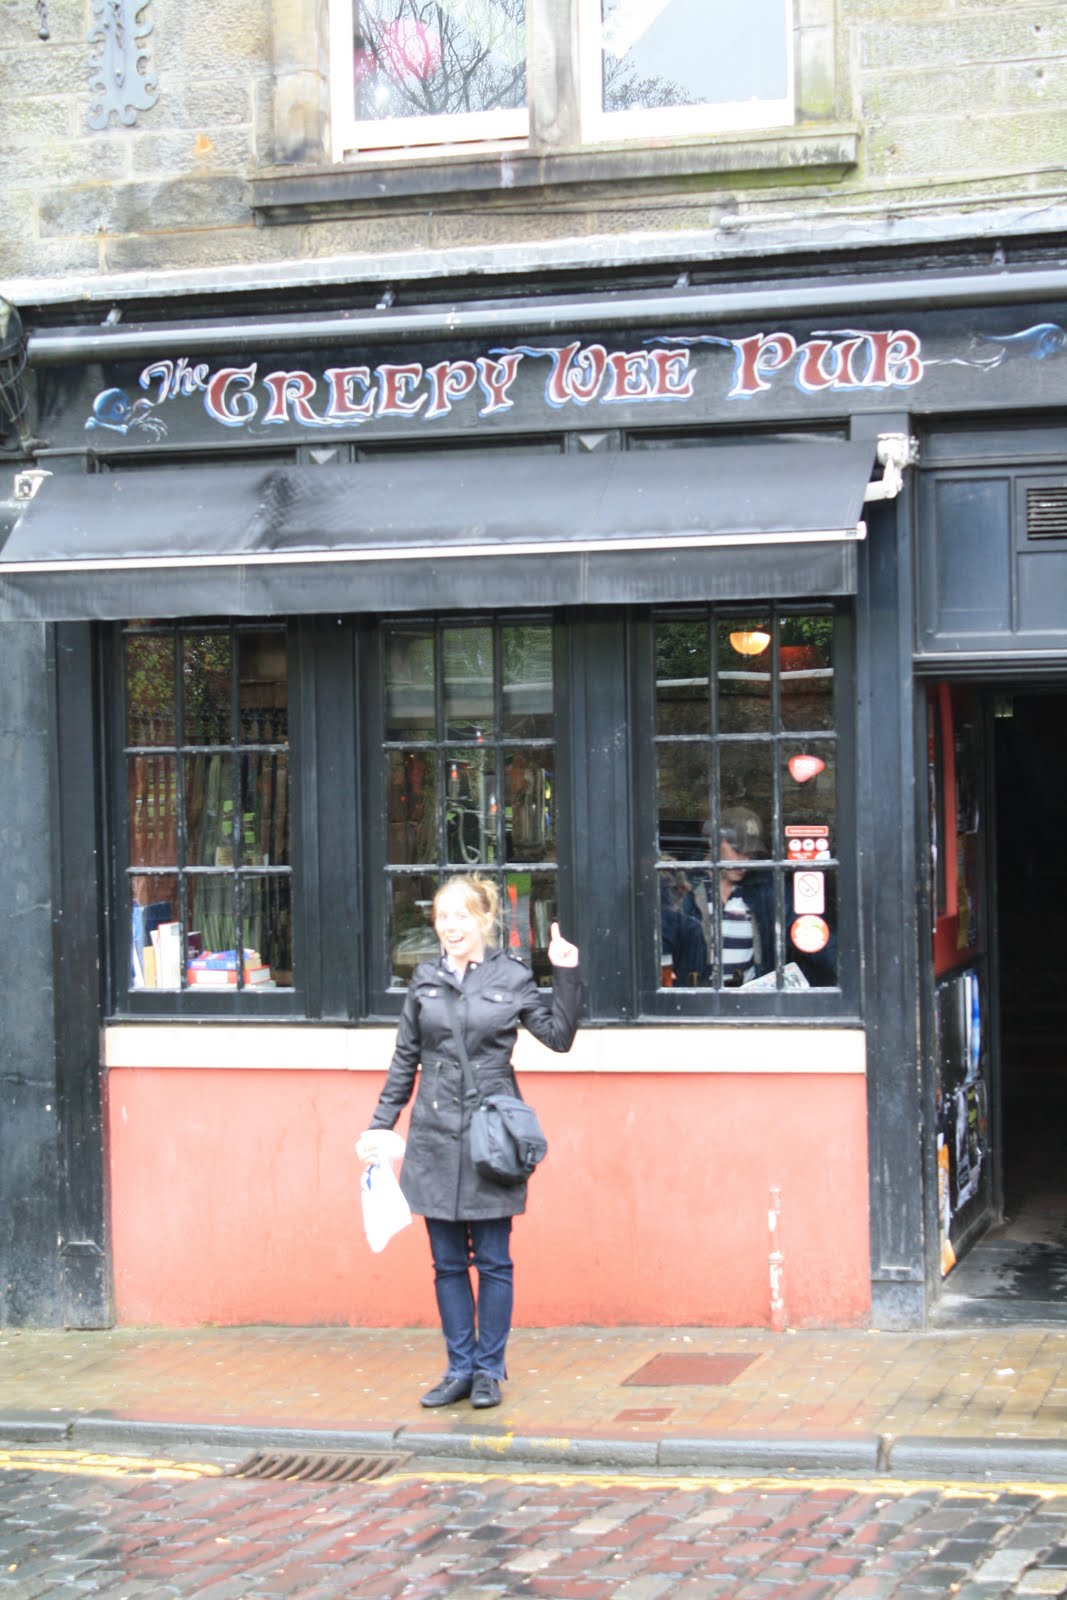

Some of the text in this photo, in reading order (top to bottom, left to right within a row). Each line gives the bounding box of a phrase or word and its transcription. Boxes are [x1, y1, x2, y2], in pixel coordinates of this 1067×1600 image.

[140, 330, 923, 427] The CREEPY WEE PUB
